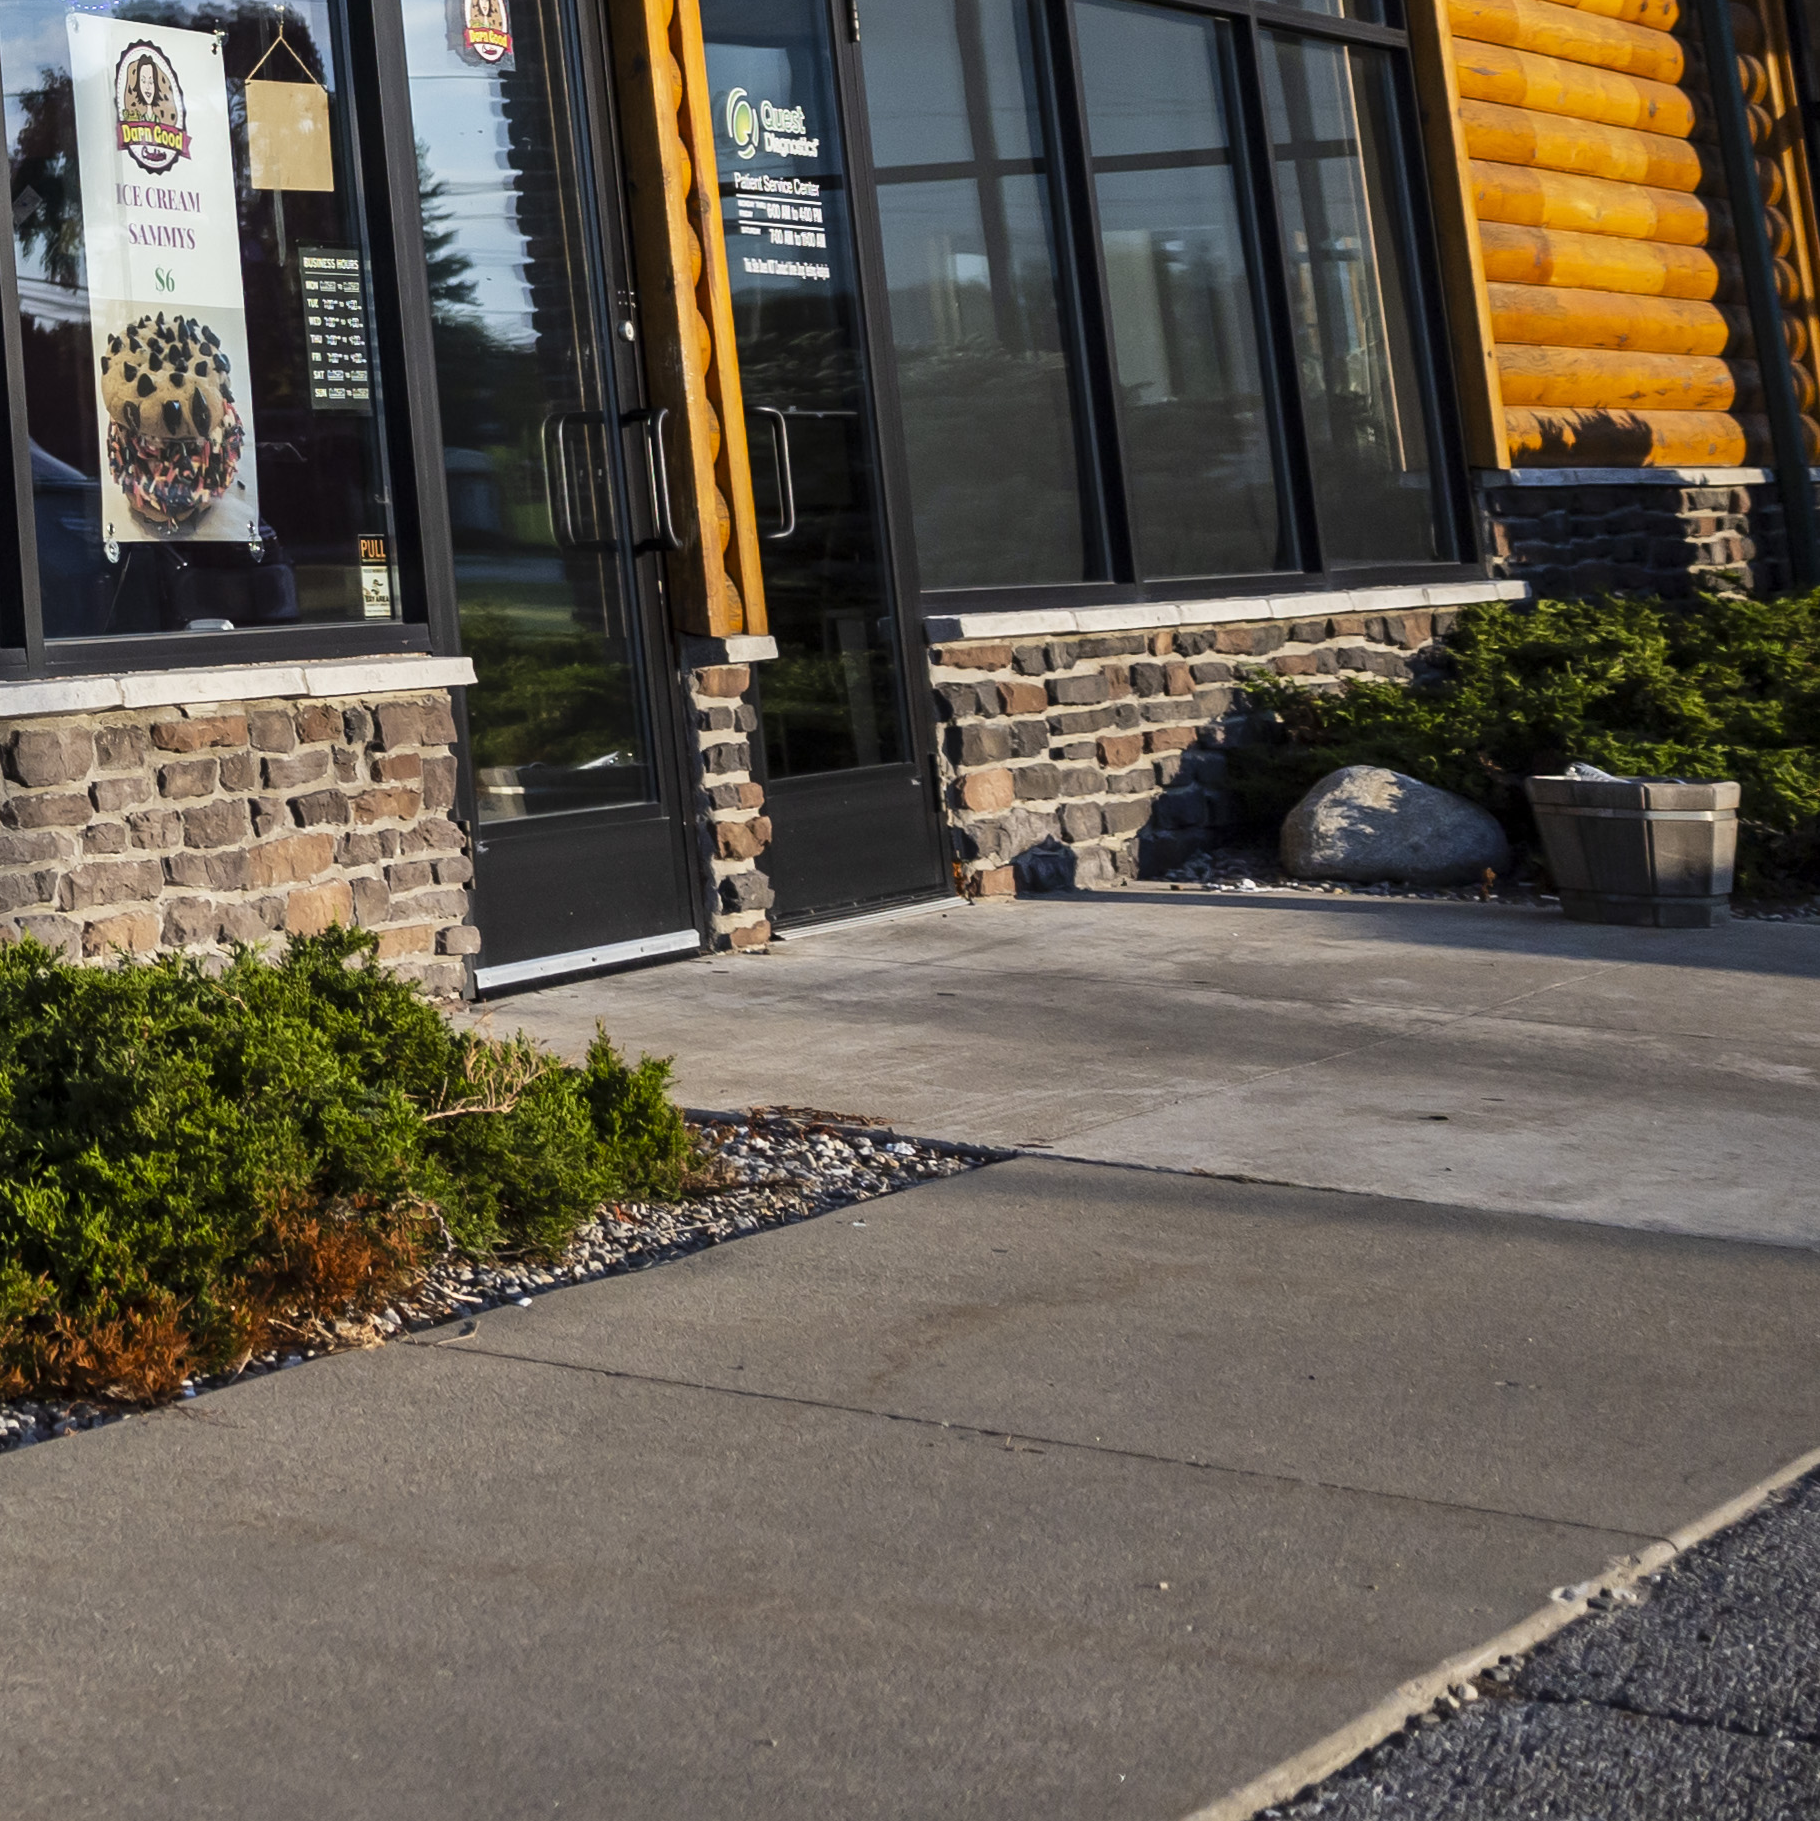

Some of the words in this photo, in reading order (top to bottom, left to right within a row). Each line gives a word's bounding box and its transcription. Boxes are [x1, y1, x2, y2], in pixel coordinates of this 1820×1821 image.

[761, 100, 806, 134] Quest
[121, 124, 152, 143] Darn
[153, 125, 183, 150] Good
[734, 172, 763, 191] Patient
[763, 175, 793, 194] Service
[793, 178, 820, 196] Center
[115, 183, 142, 207] ICE
[146, 187, 201, 213] CREAM
[128, 223, 196, 250] SAMMYS
[303, 257, 335, 269] BUSINESS
[336, 259, 359, 270] HOURS
[155, 265, 175, 294] $6
[360, 539, 386, 558] PULL
